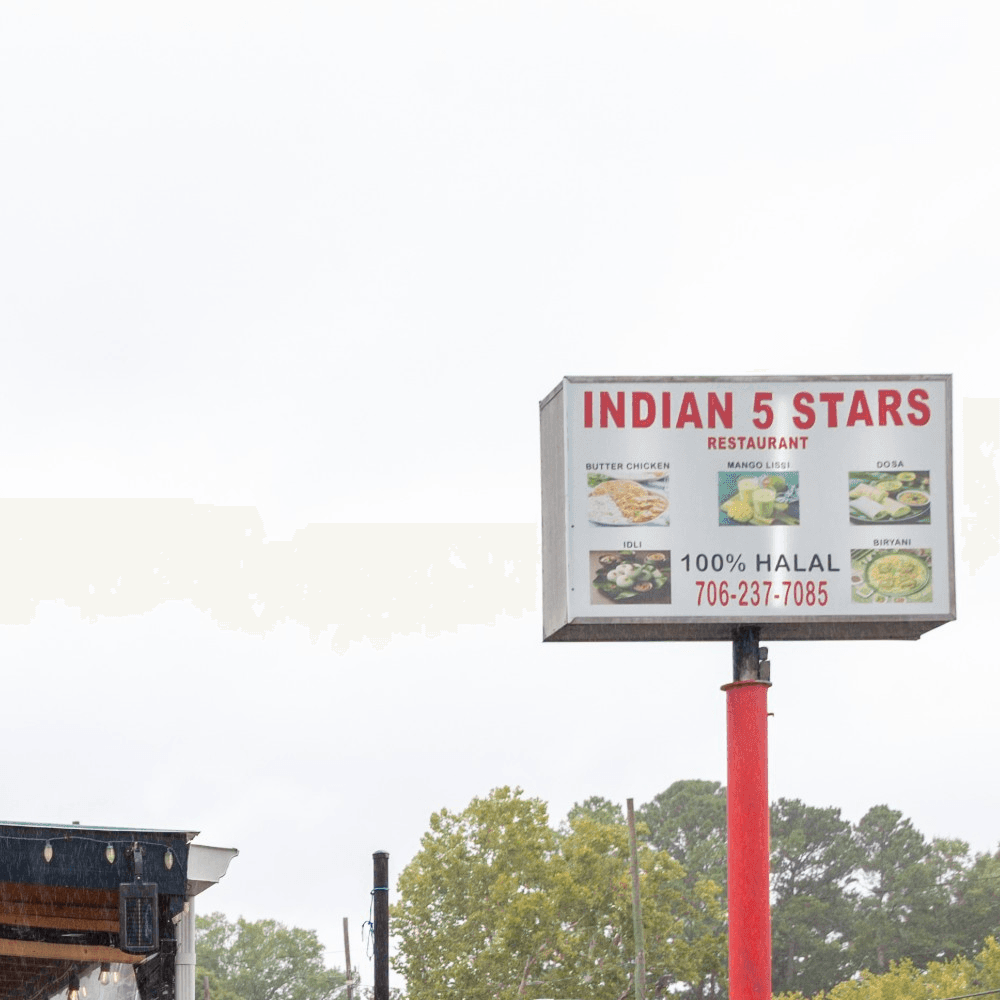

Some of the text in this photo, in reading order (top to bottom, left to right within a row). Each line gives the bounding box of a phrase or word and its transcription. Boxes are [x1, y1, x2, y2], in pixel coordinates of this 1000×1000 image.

[583, 388, 931, 430] INDIAN 5 STARS
[707, 436, 809, 450] RESTAURANT
[585, 462, 670, 471] BUTTER CHICKEN
[727, 461, 763, 469] MANGO
[876, 460, 904, 468] DOSA
[623, 541, 642, 549] IDLI
[873, 538, 912, 546] BIRYANI
[681, 553, 840, 572] 100% HALAL
[695, 580, 828, 607] 706-237-7085
